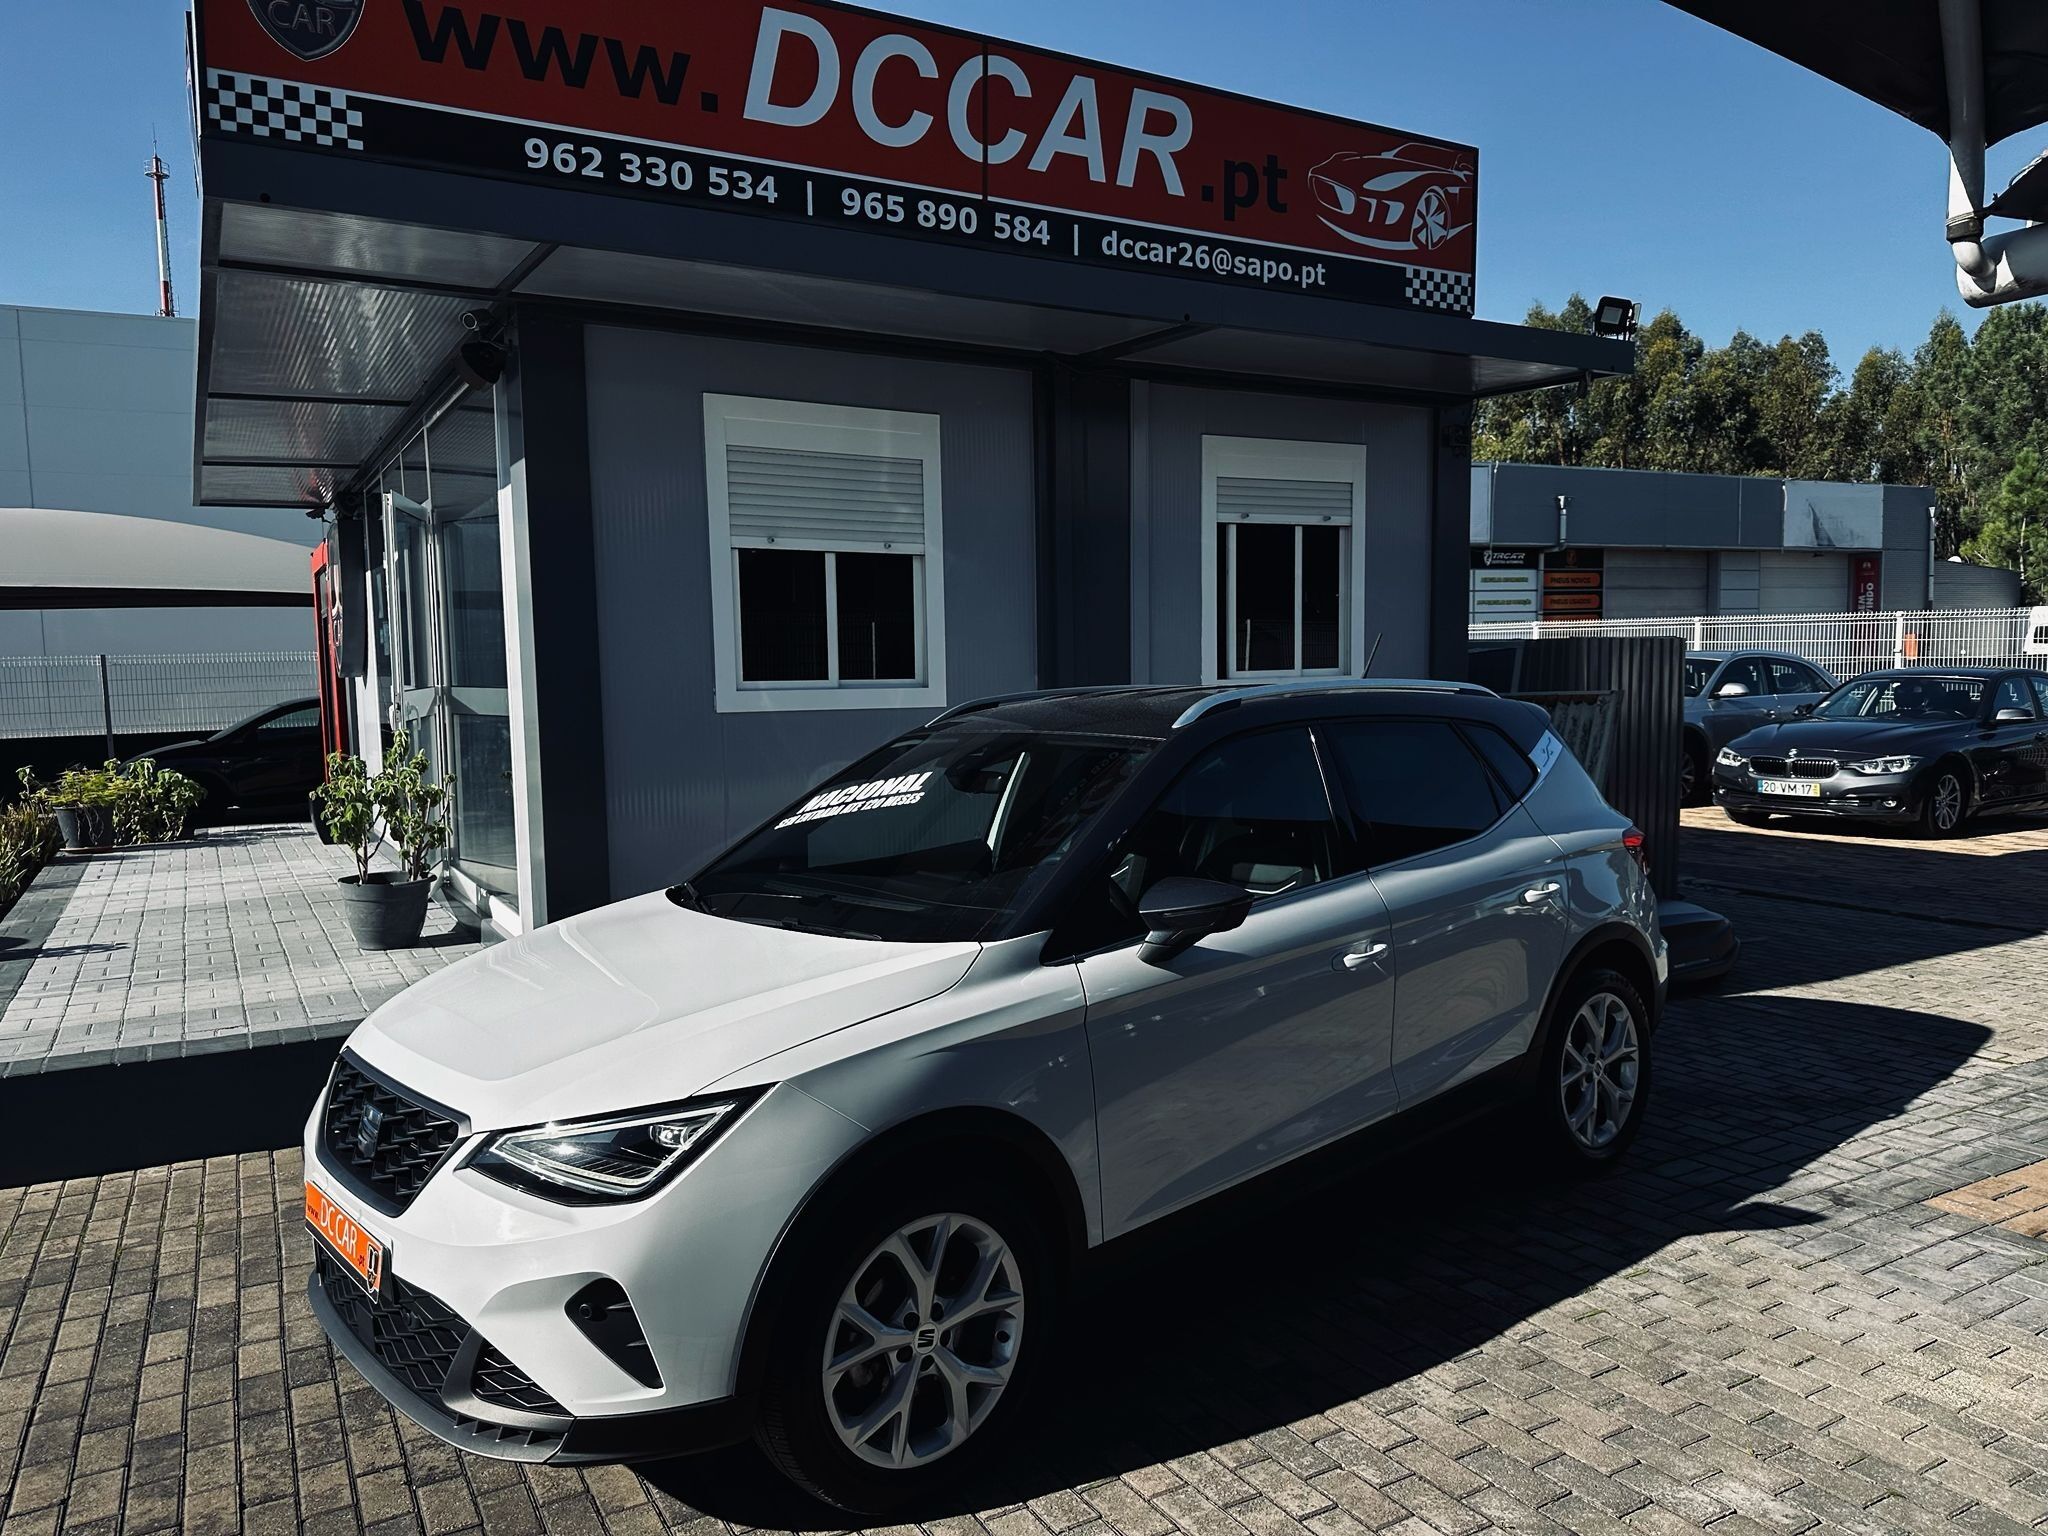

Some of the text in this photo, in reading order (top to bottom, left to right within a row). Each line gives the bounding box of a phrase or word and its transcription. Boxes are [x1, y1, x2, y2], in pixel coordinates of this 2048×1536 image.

[267, 0, 337, 38] CAR
[524, 137, 1326, 289] 962 330 534 965 890 584 dccar26@sapo.pt
[796, 771, 933, 815] NACIONAL
[861, 797, 886, 811] 120
[881, 792, 925, 807] MESES
[1764, 782, 1776, 792] 20
[1780, 783, 1797, 794] VM
[1801, 784, 1812, 795] 17
